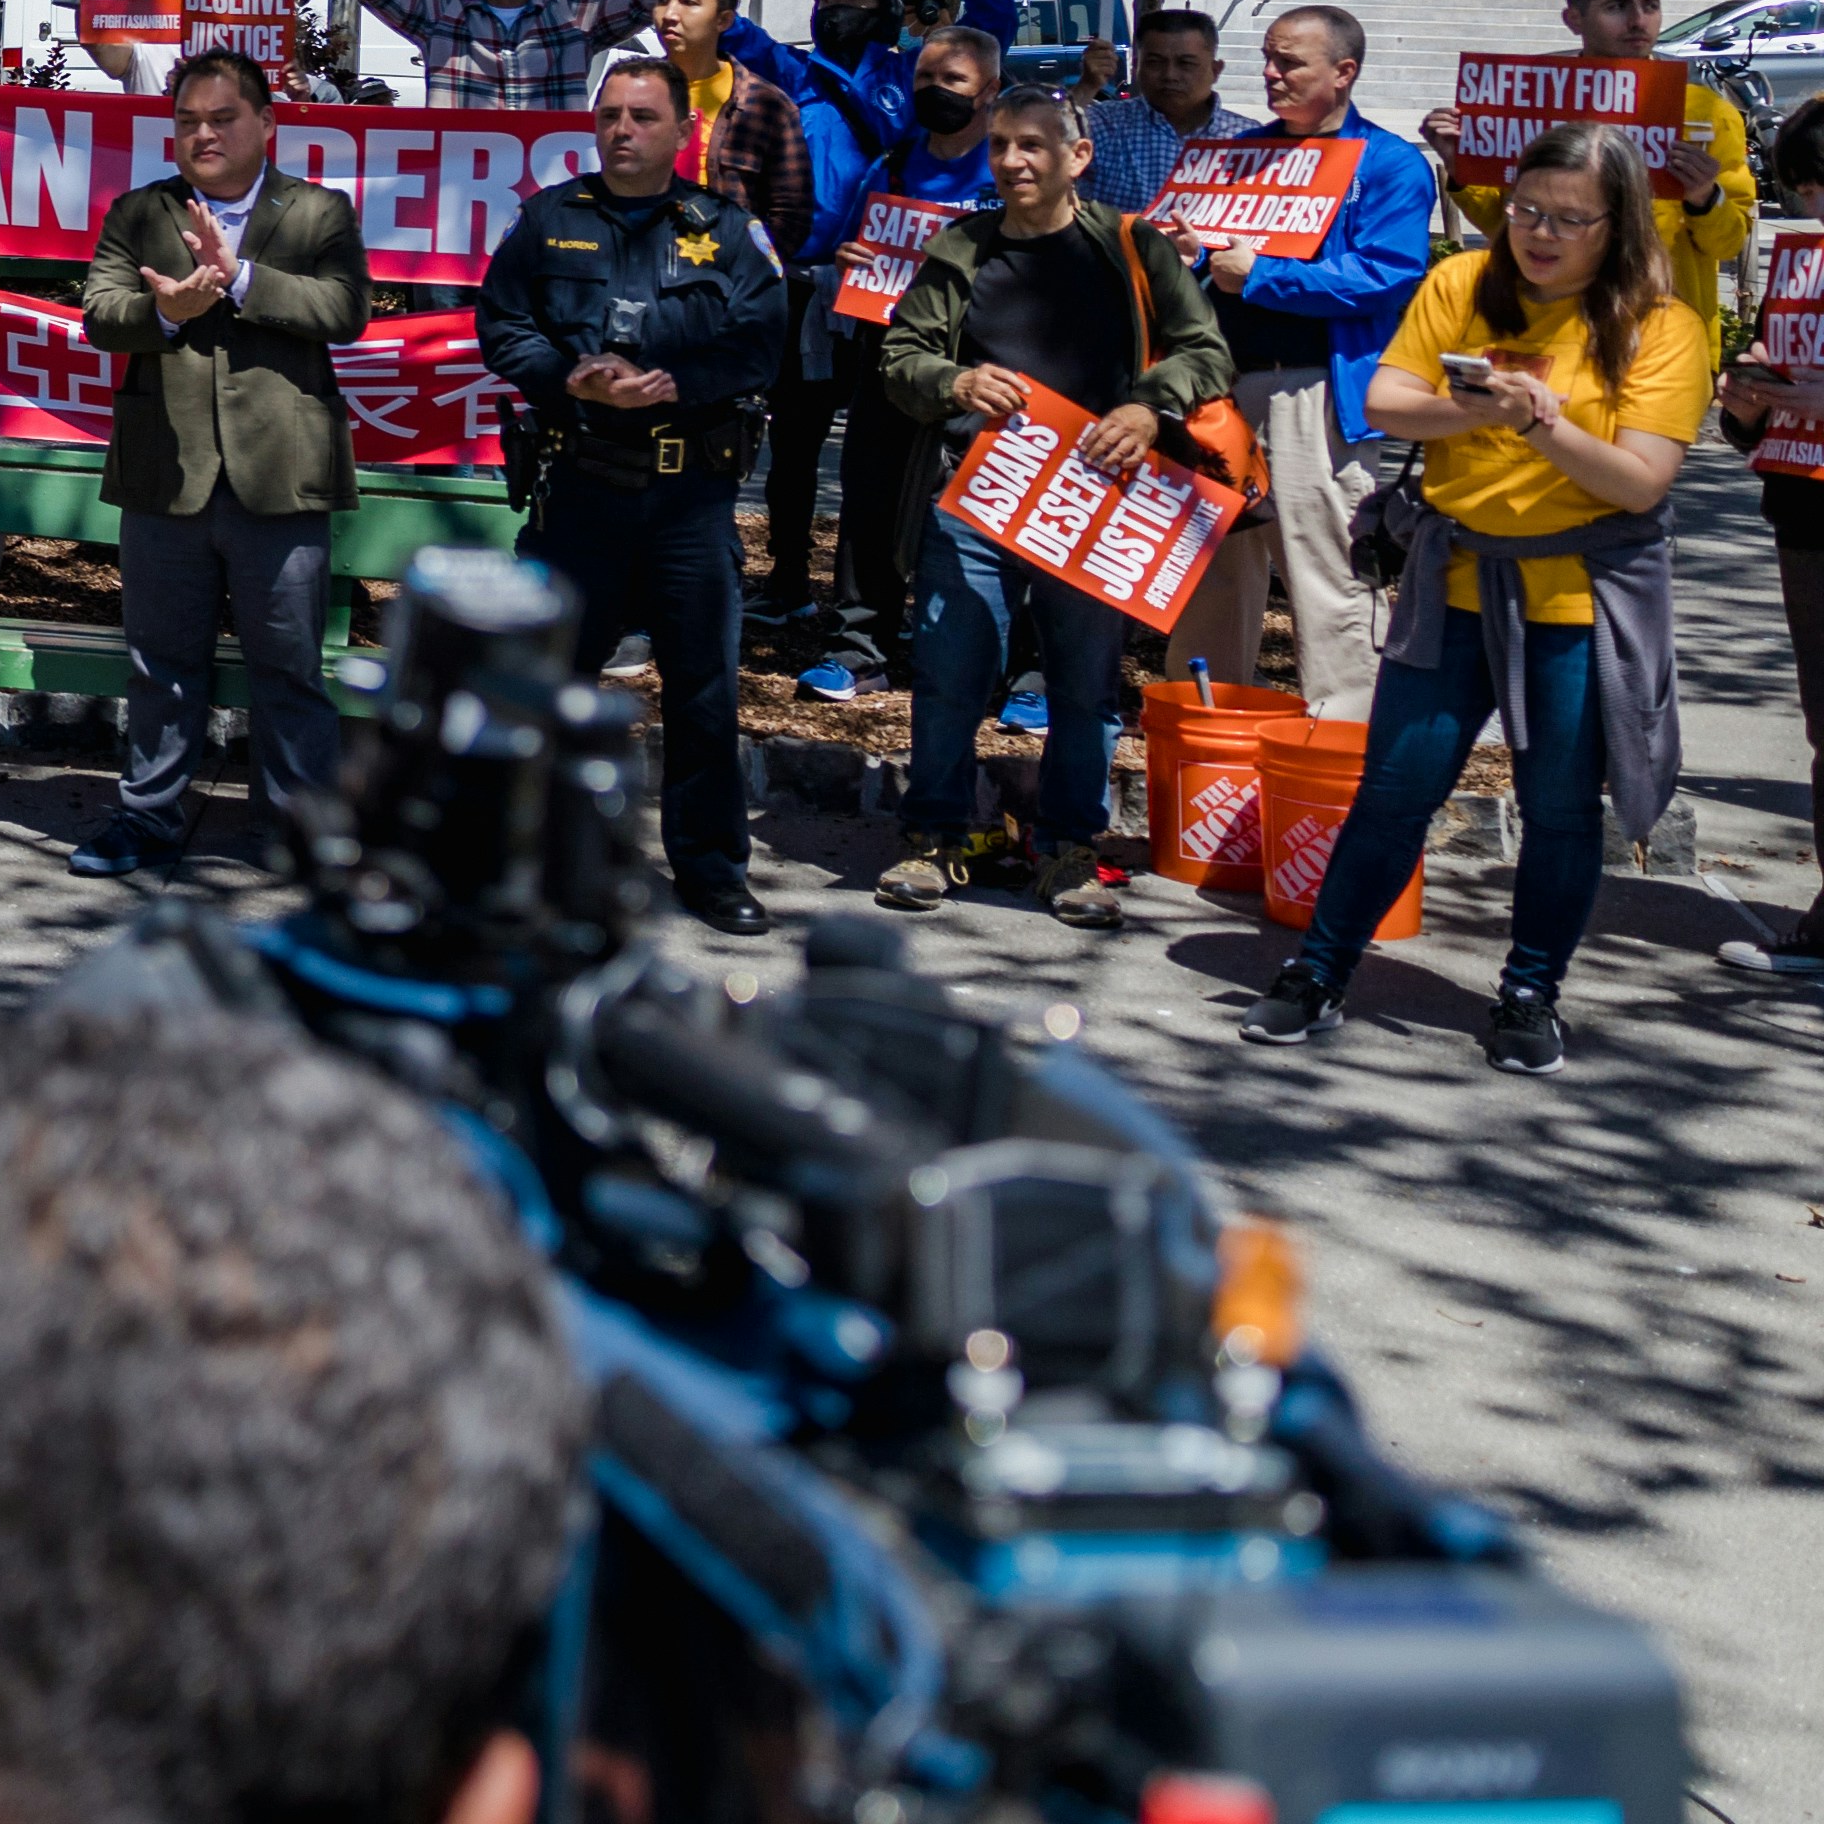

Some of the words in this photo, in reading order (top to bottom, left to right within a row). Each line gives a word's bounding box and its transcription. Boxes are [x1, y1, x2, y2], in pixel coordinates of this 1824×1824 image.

[92, 14, 181, 30] #FIGHTASIANHATE
[184, 21, 285, 62] JUSTICE
[1459, 62, 1570, 109] SAFETY
[1574, 67, 1637, 114] FOR
[132, 113, 599, 264] DERS
[1173, 148, 1271, 185] SAFETY
[1262, 149, 1322, 187] FOR
[1144, 192, 1233, 227] ASIAN
[1226, 194, 1337, 234] ELDERS!
[559, 240, 599, 251] MORENO
[846, 254, 915, 297] ASIA
[958, 411, 1060, 535] ASIANS
[1015, 422, 1122, 569] DESER
[1082, 463, 1193, 601] JUSTICE
[1143, 498, 1224, 611] #FIGHTASIANHATE
[1190, 776, 1239, 814] THE
[1181, 777, 1261, 860] HOM
[1281, 814, 1323, 851] THE
